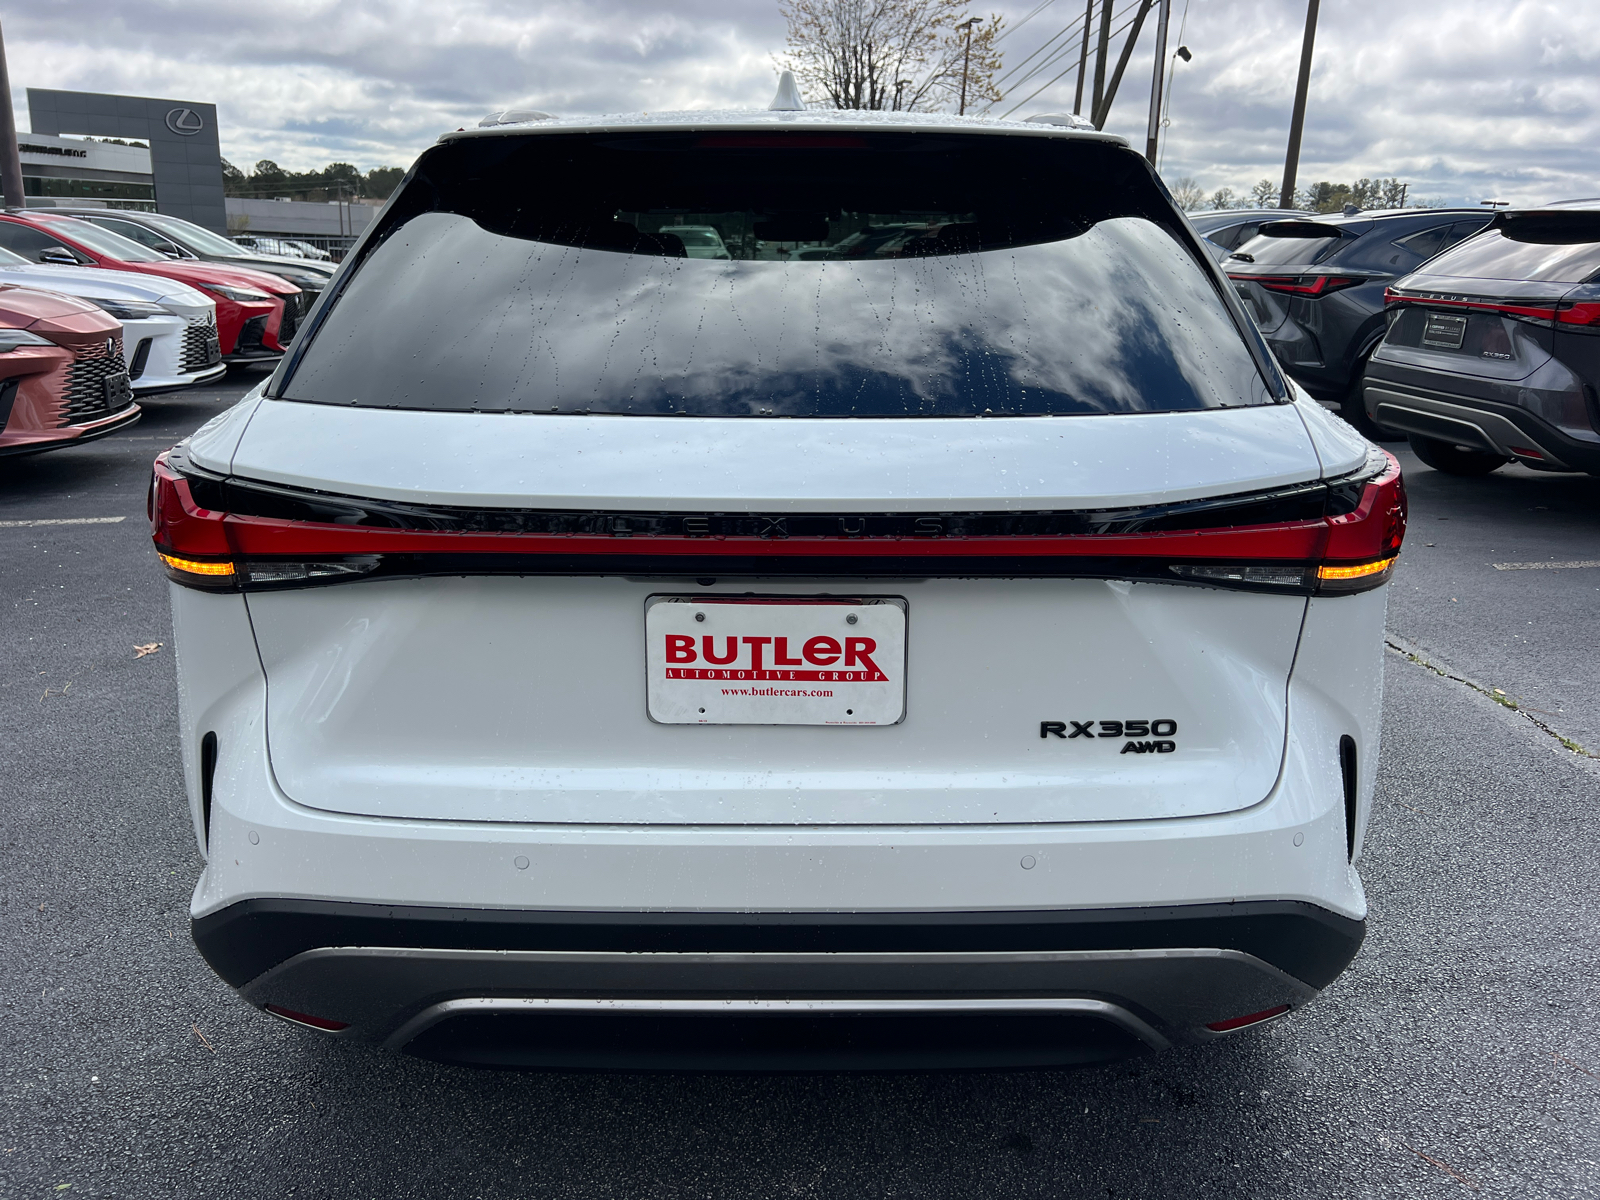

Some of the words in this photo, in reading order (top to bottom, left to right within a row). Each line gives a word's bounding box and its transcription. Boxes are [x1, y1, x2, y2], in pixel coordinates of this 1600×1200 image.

[1419, 293, 1469, 302] LEXUS
[607, 516, 943, 534] LEXUS
[667, 669, 796, 680] AUTOMOTIVE
[818, 671, 882, 681] GROUP
[721, 687, 834, 698] www.butlercars.com
[1040, 719, 1178, 739] RX350
[1120, 740, 1177, 754] AWD
